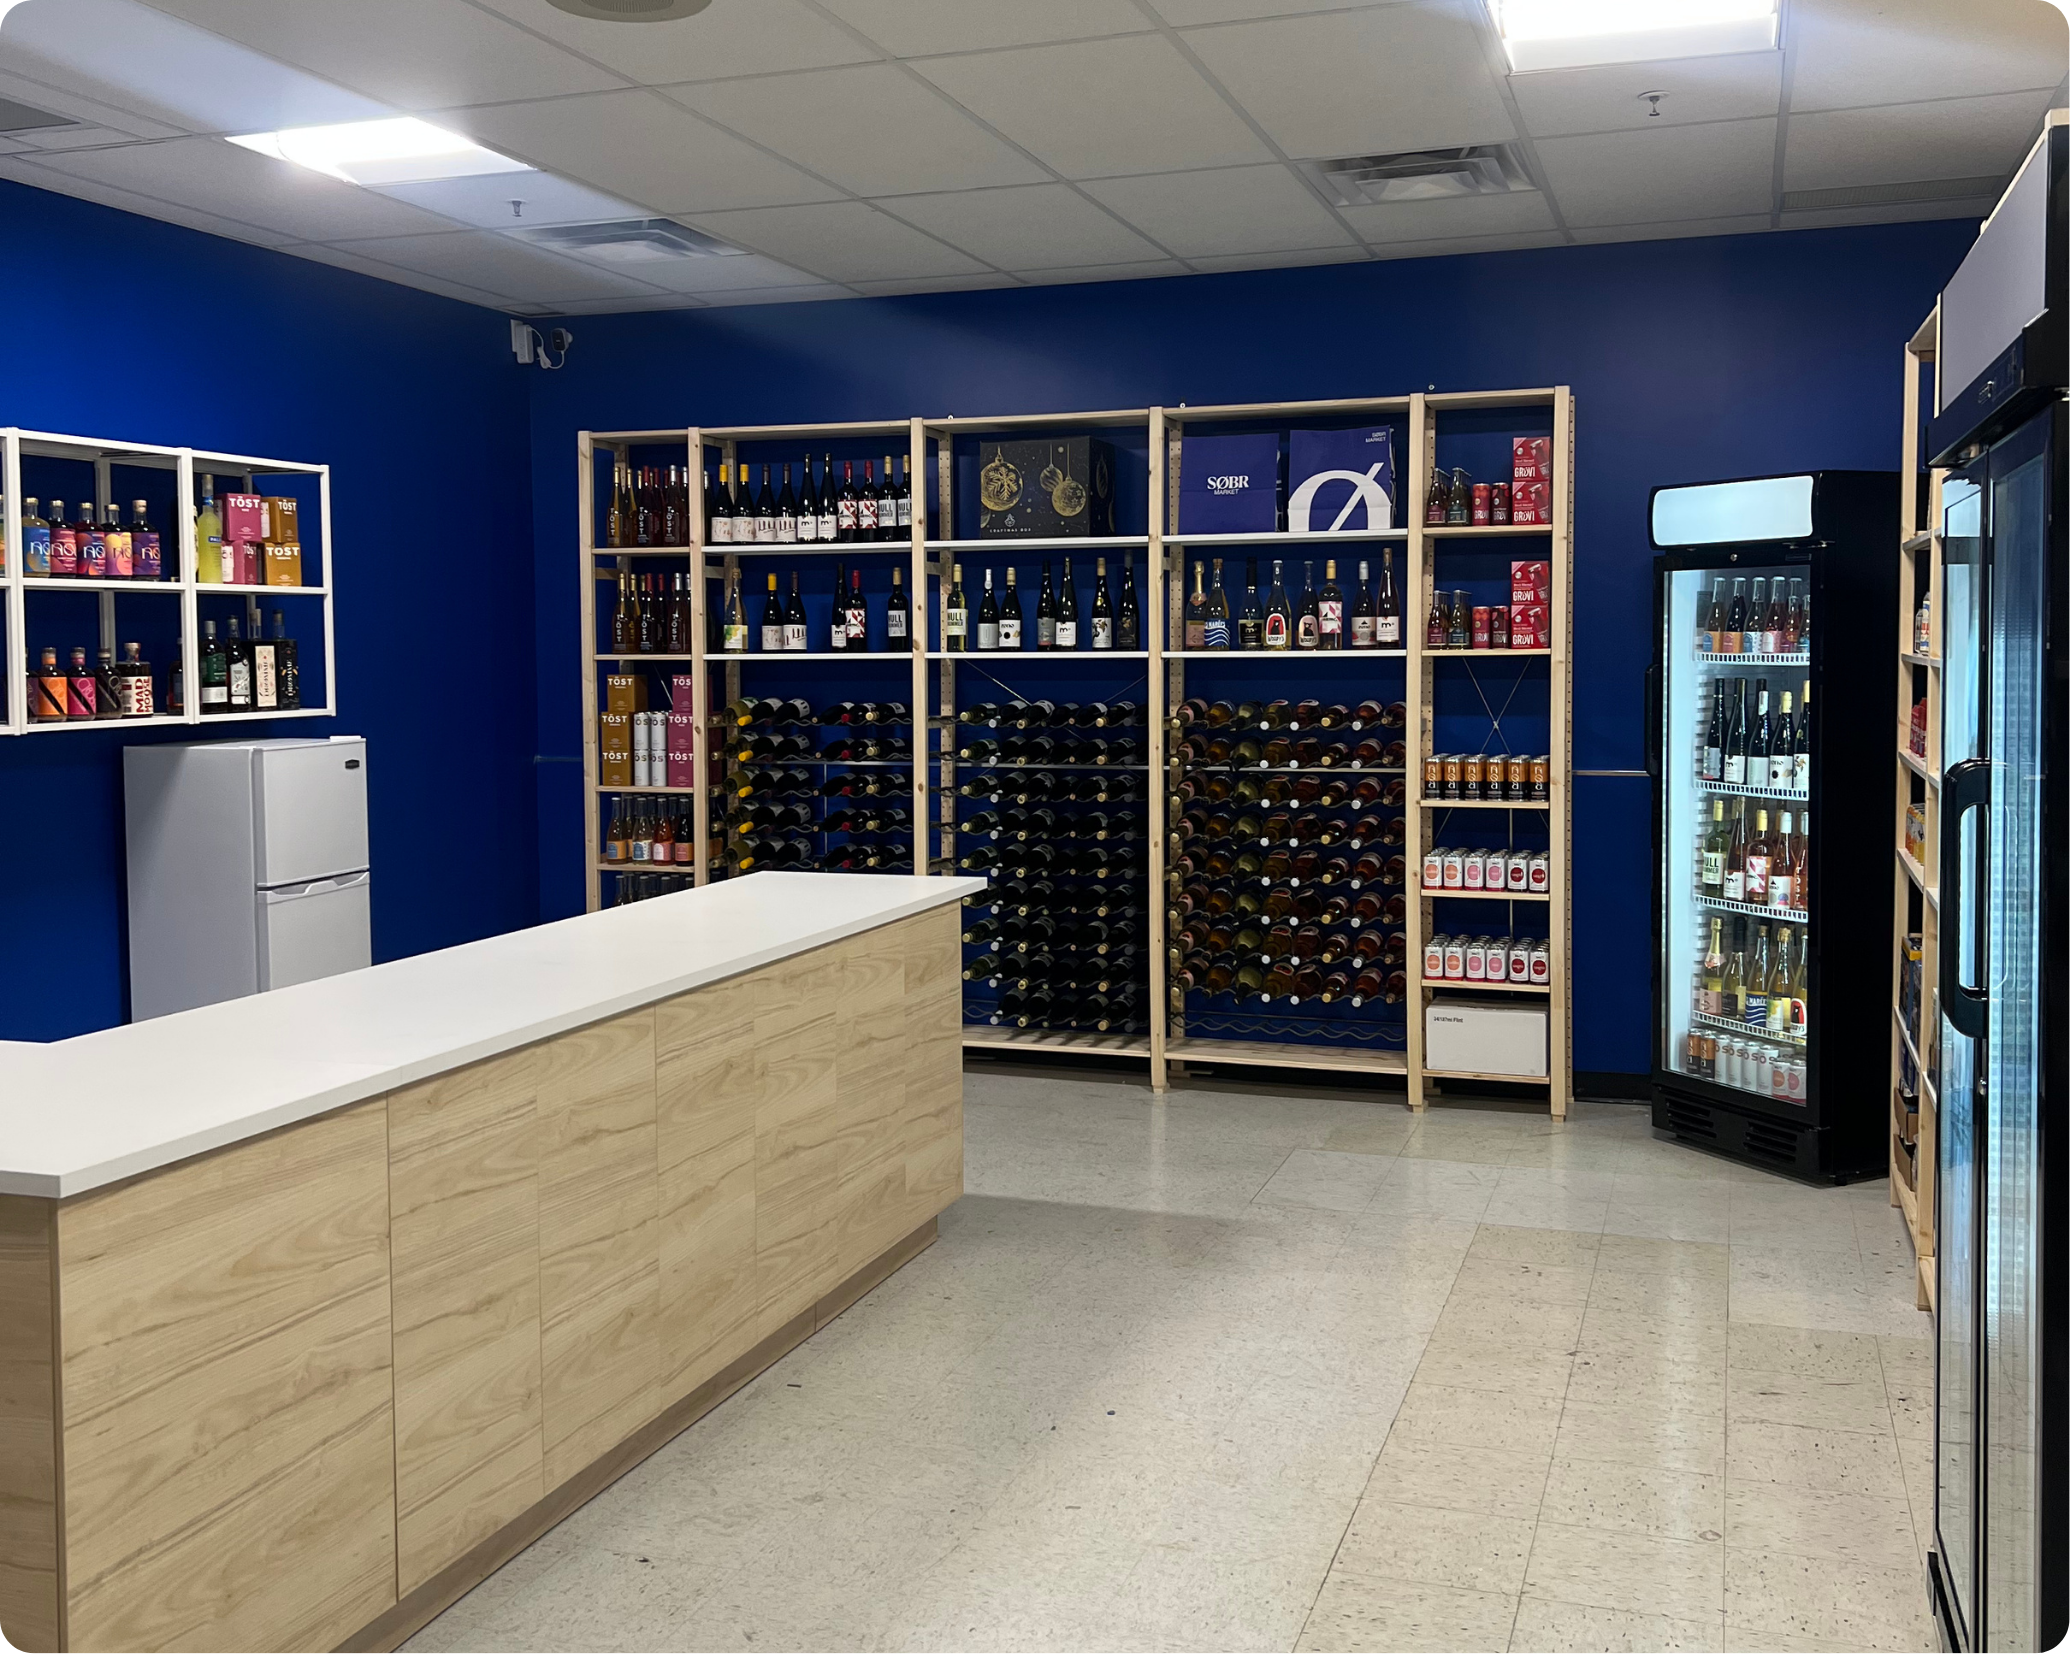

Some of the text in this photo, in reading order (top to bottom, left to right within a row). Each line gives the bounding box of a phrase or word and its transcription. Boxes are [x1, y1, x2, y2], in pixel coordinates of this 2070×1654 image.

[1207, 475, 1249, 489] SØBR
[135, 678, 143, 713] MAD
[144, 677, 153, 713] MOOSE
